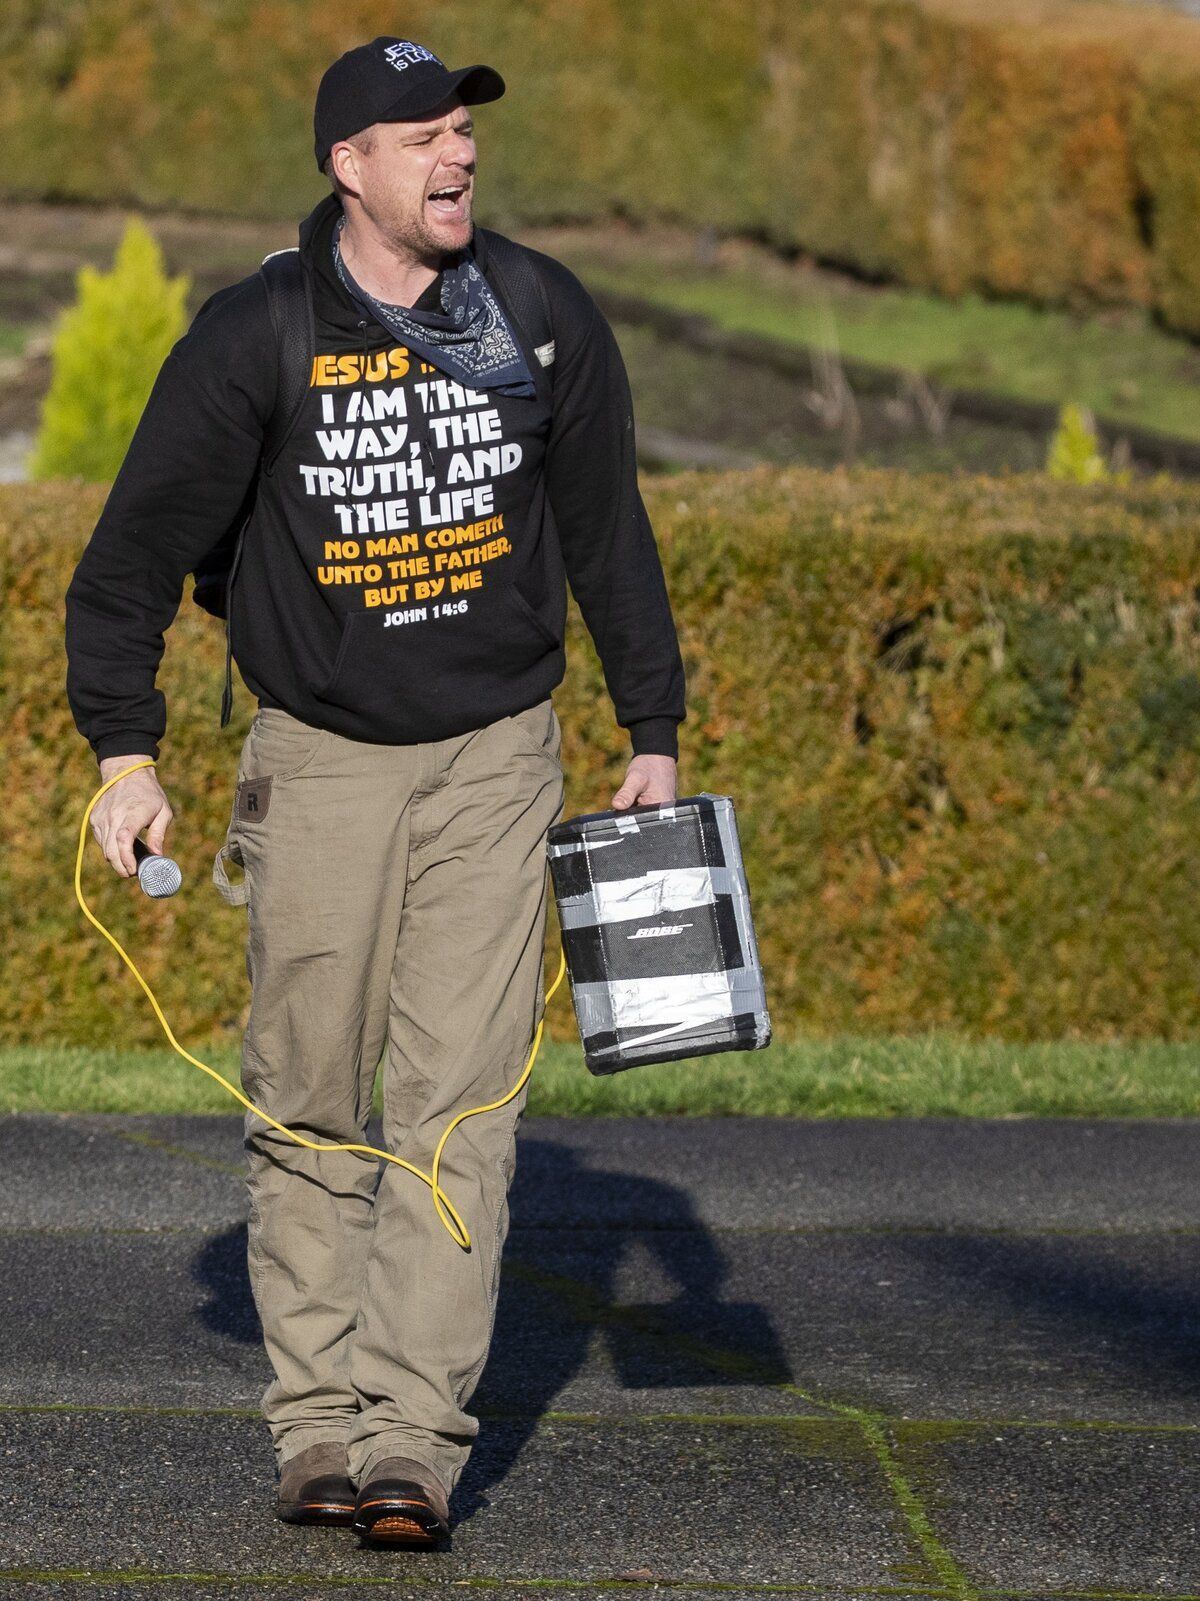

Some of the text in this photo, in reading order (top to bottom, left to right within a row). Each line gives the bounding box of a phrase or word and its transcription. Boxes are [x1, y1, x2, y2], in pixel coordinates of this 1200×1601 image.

[390, 60, 409, 72] is
[321, 380, 489, 424] I AM THE
[315, 409, 503, 461] WAY, THE
[299, 443, 523, 497] TRUTH, AND
[334, 484, 494, 535] THE LIFE
[324, 513, 505, 560] NO MAN COMETH
[317, 536, 512, 585] UNTO THE FATHER,
[364, 569, 483, 608] BUT BY ME
[383, 599, 469, 628] JOHN 14:6
[247, 792, 259, 812] R
[626, 923, 694, 940] BOSE
